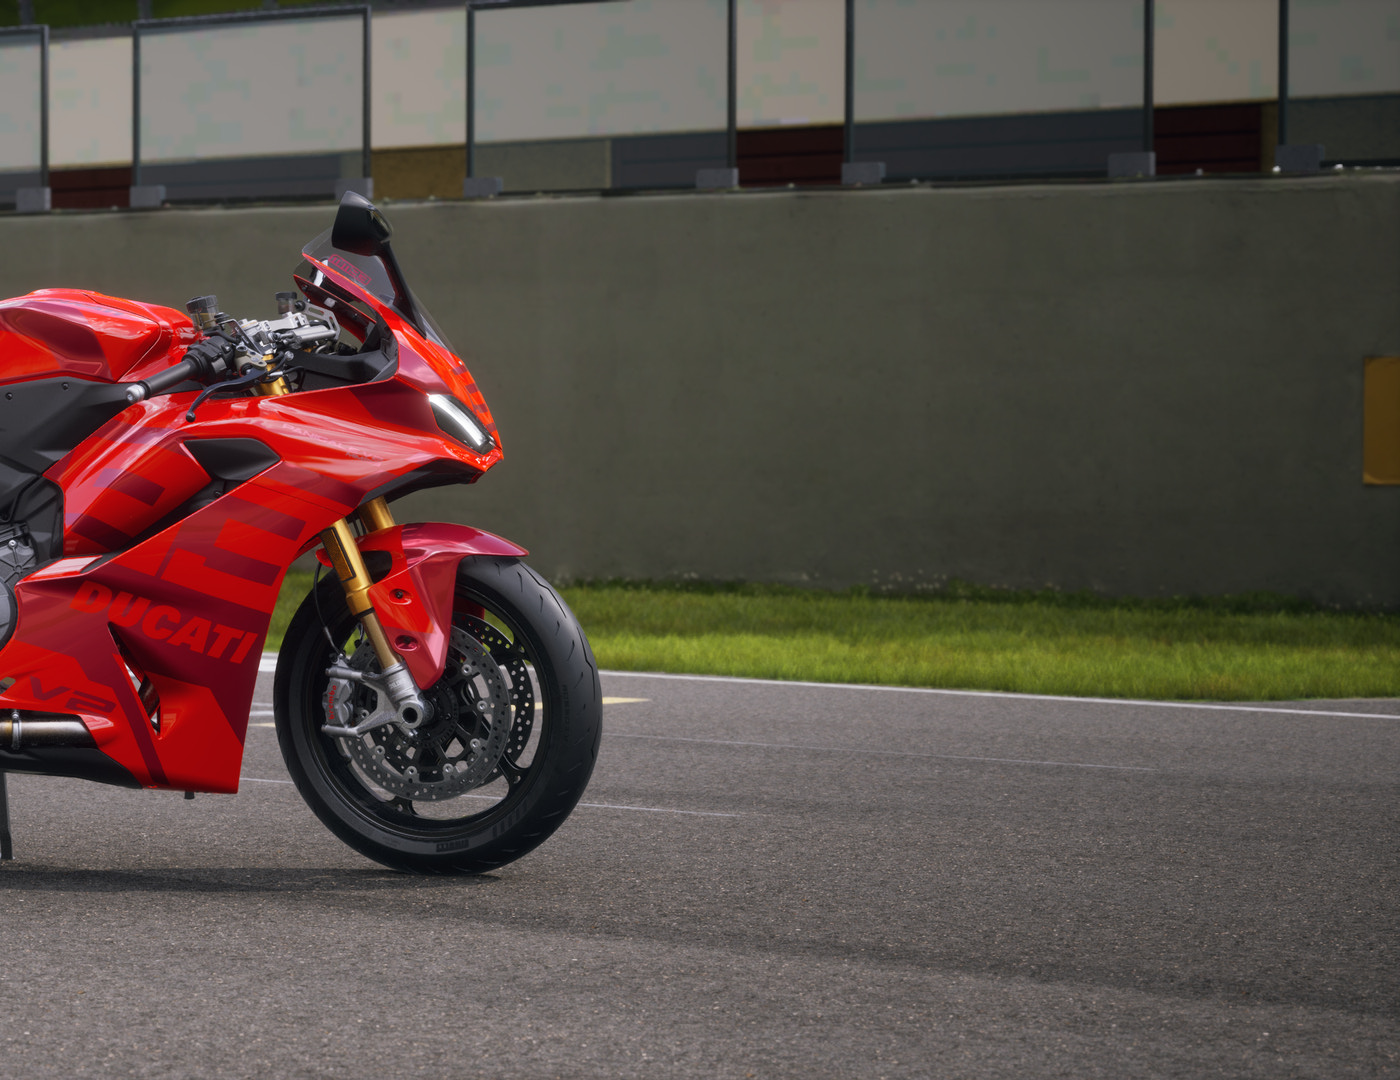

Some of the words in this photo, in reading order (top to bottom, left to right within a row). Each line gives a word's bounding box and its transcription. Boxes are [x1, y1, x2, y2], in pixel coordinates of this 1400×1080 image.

[68, 580, 259, 665] DUCATI
[29, 675, 117, 714] V2
[328, 685, 338, 720] brembo
